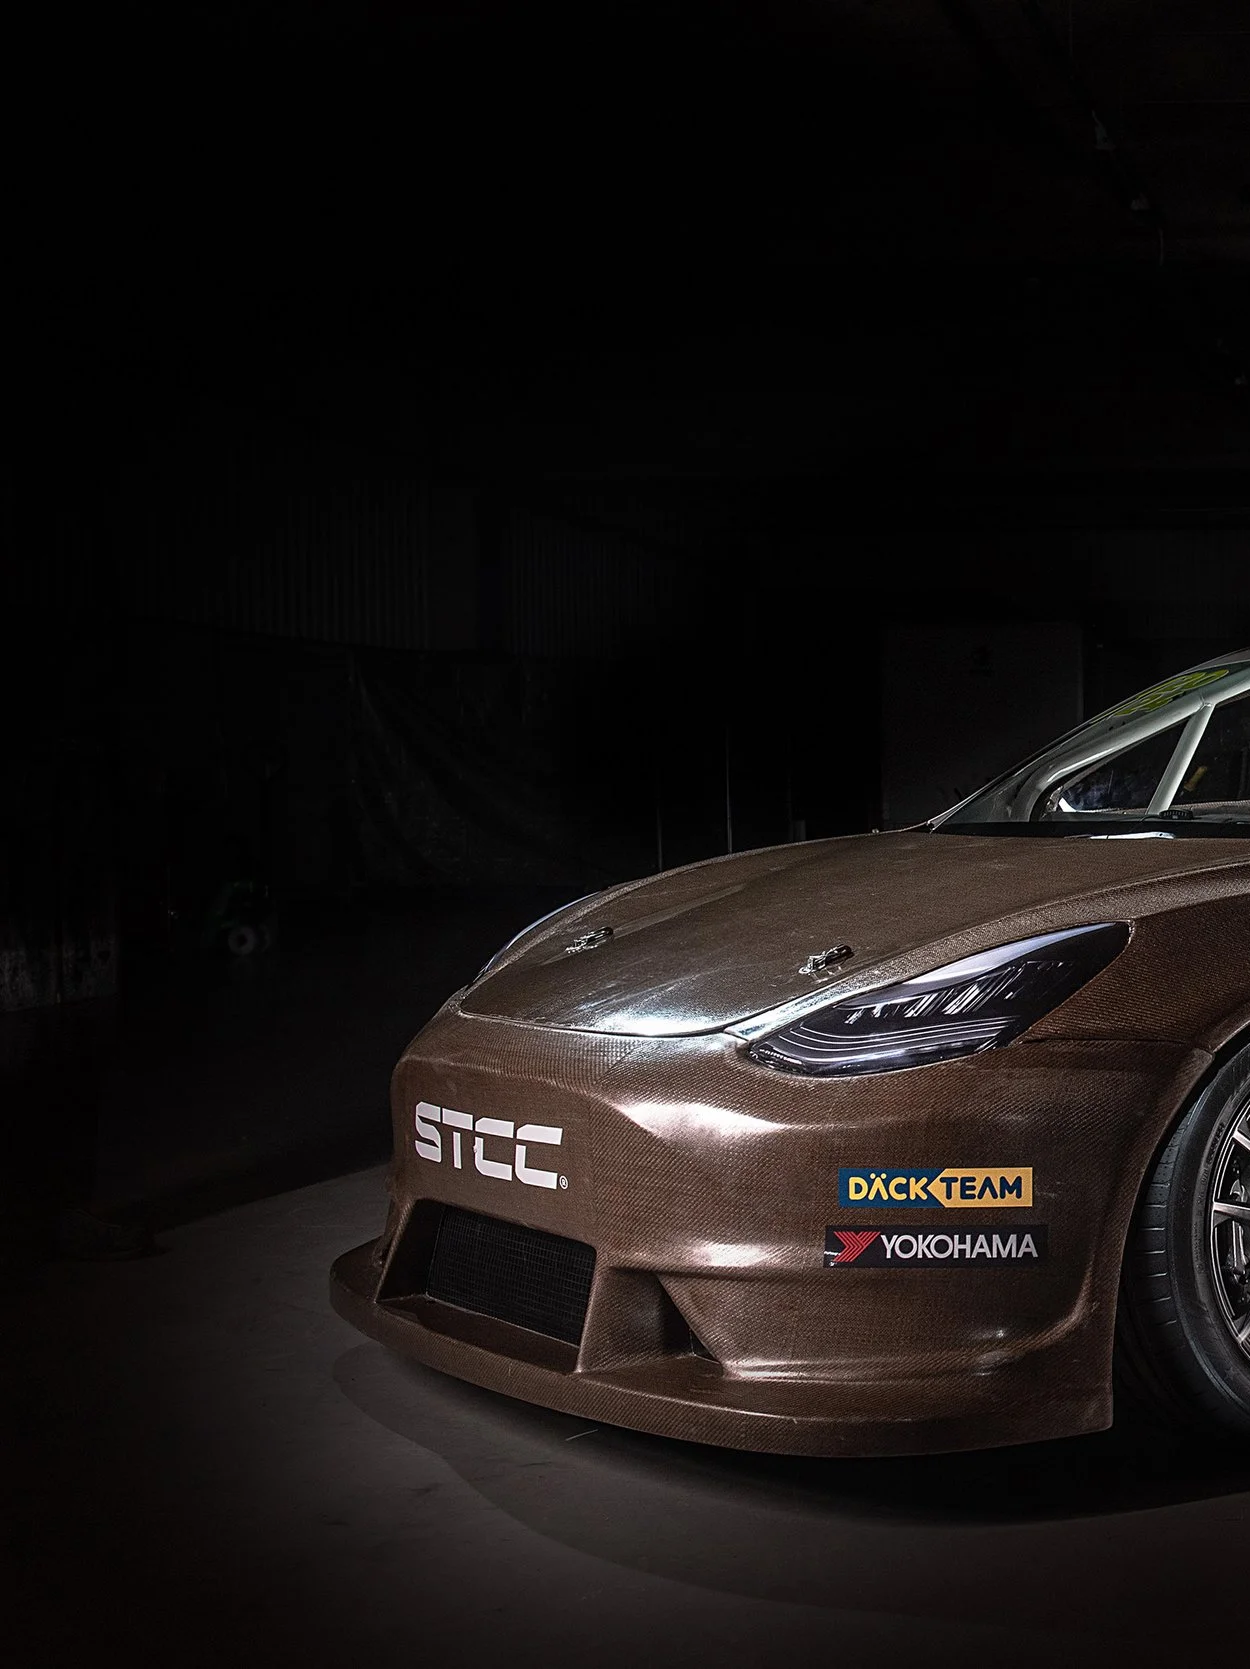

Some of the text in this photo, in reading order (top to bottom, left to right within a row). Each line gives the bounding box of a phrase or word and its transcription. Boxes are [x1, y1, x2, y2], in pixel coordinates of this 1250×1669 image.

[848, 1172, 1023, 1200] DÄCK TEAM
[880, 1233, 1039, 1259] YOKOHAMA
